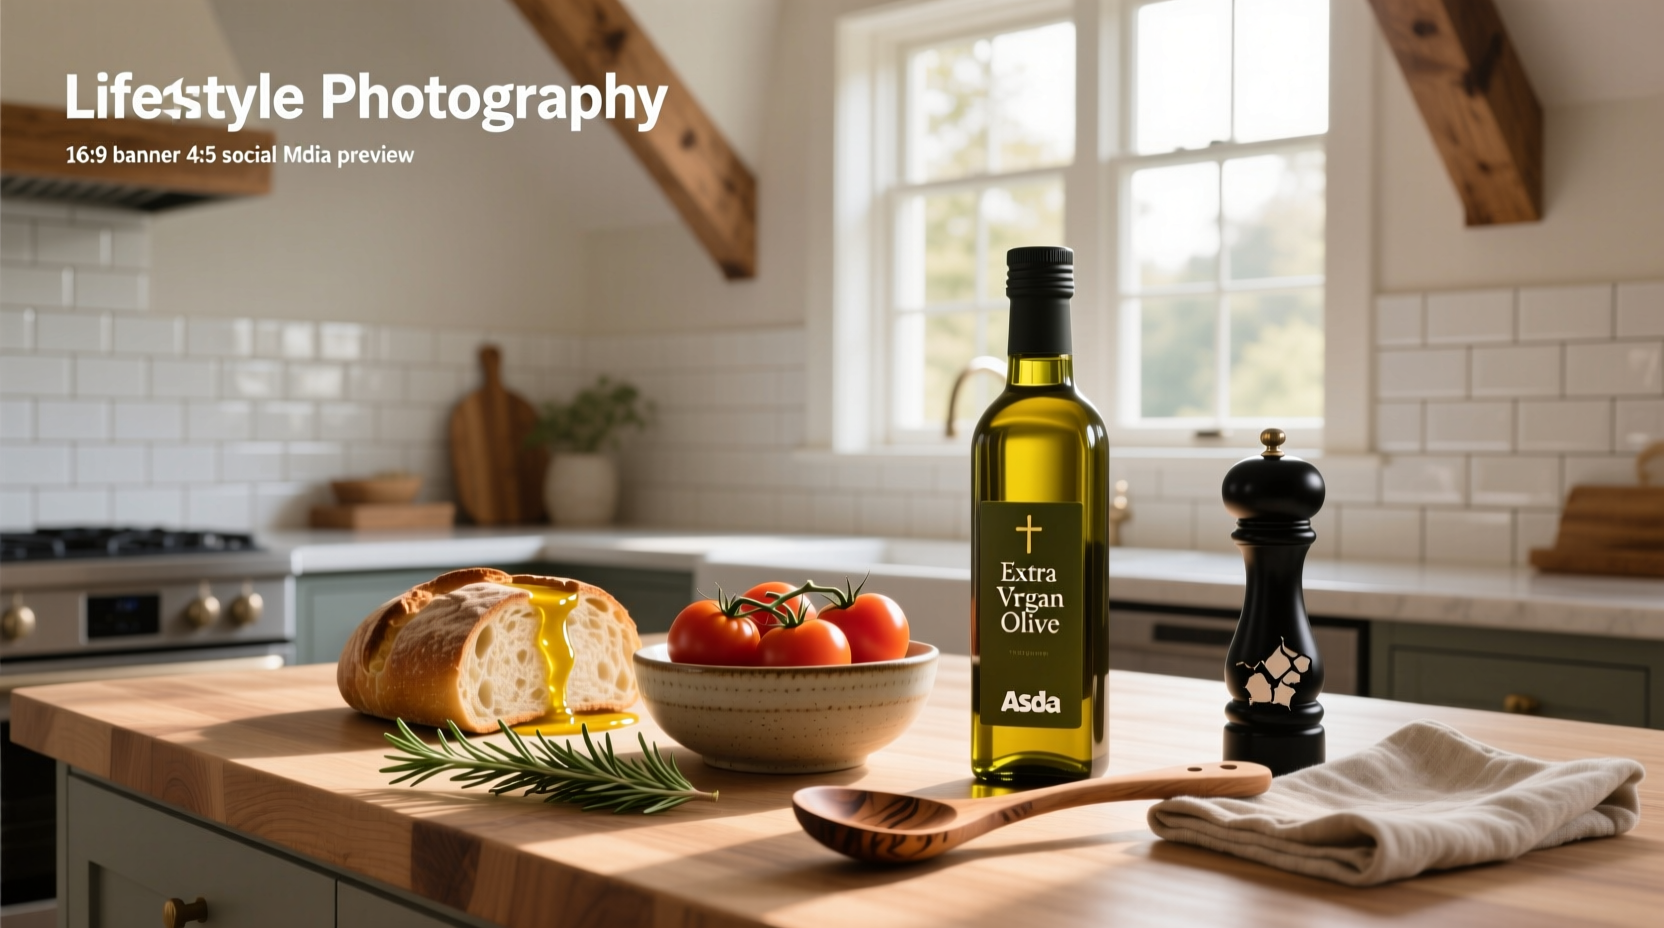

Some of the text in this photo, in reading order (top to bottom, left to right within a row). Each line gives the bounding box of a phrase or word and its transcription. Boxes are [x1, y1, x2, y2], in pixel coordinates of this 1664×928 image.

[1000, 561, 1057, 582] Extra
[996, 586, 1064, 613] Vrgan
[1001, 611, 1060, 634] Olive
[1001, 690, 1061, 713] Asda
